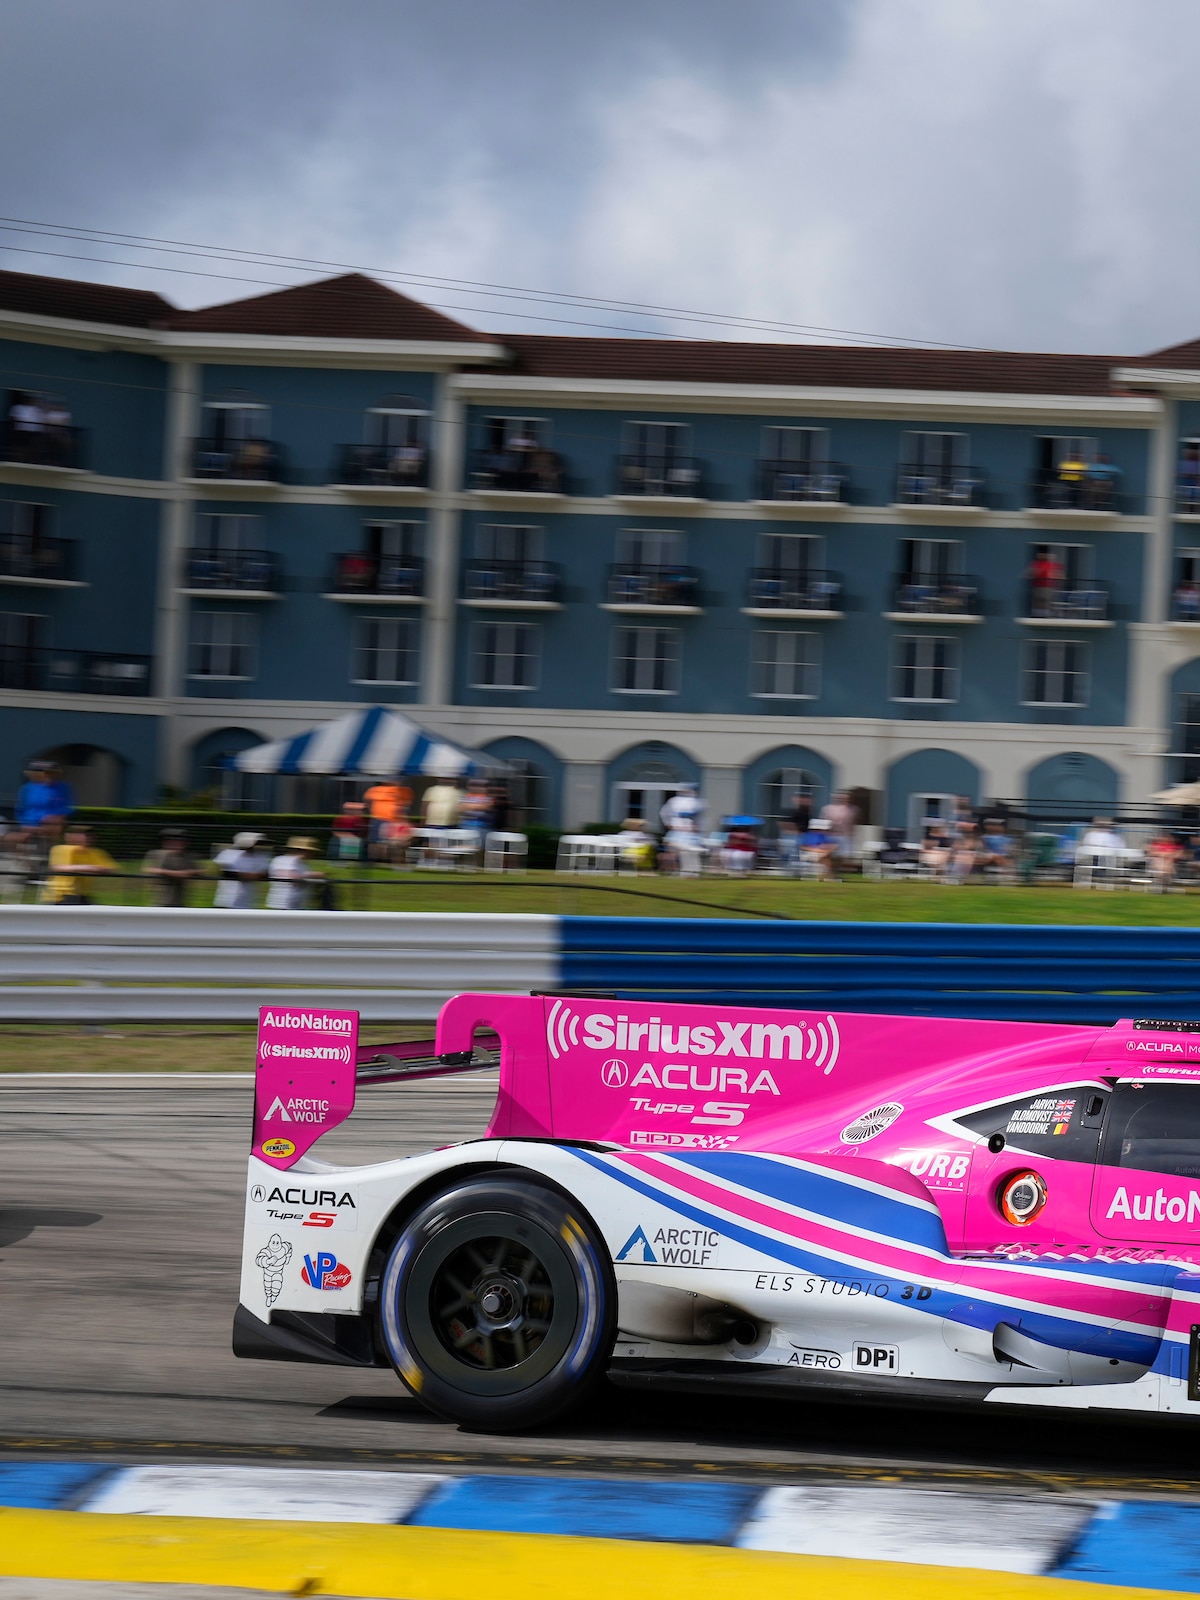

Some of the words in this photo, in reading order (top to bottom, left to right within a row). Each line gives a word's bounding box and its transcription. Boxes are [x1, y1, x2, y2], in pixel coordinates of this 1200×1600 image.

[262, 1012, 352, 1031] AutoNation
[1136, 1042, 1183, 1052] ACURA
[630, 1063, 781, 1095] ACURA
[288, 1098, 330, 1112] ARCTIC
[630, 1098, 695, 1114] Type
[690, 1101, 750, 1126] S
[1030, 1099, 1058, 1110] JARVIS
[293, 1110, 326, 1123] WOLF
[1011, 1110, 1054, 1122] BLOMQVIST
[1006, 1122, 1050, 1134] VANDOORNE
[633, 1132, 685, 1145] HPD
[904, 1153, 970, 1178] URB
[924, 1179, 964, 1188] ORDS
[267, 1188, 356, 1208] ACURA
[266, 1210, 304, 1220] Type
[302, 1212, 338, 1228] S
[654, 1228, 720, 1248] ARCTIC
[662, 1248, 712, 1265] WOLF
[304, 1252, 336, 1290] VP
[324, 1273, 352, 1286] Racing
[755, 1274, 794, 1292] ELS
[804, 1278, 890, 1299] STUDIO
[900, 1286, 932, 1301] 3D
[787, 1352, 842, 1369] AERO
[856, 1346, 895, 1370] DPi
